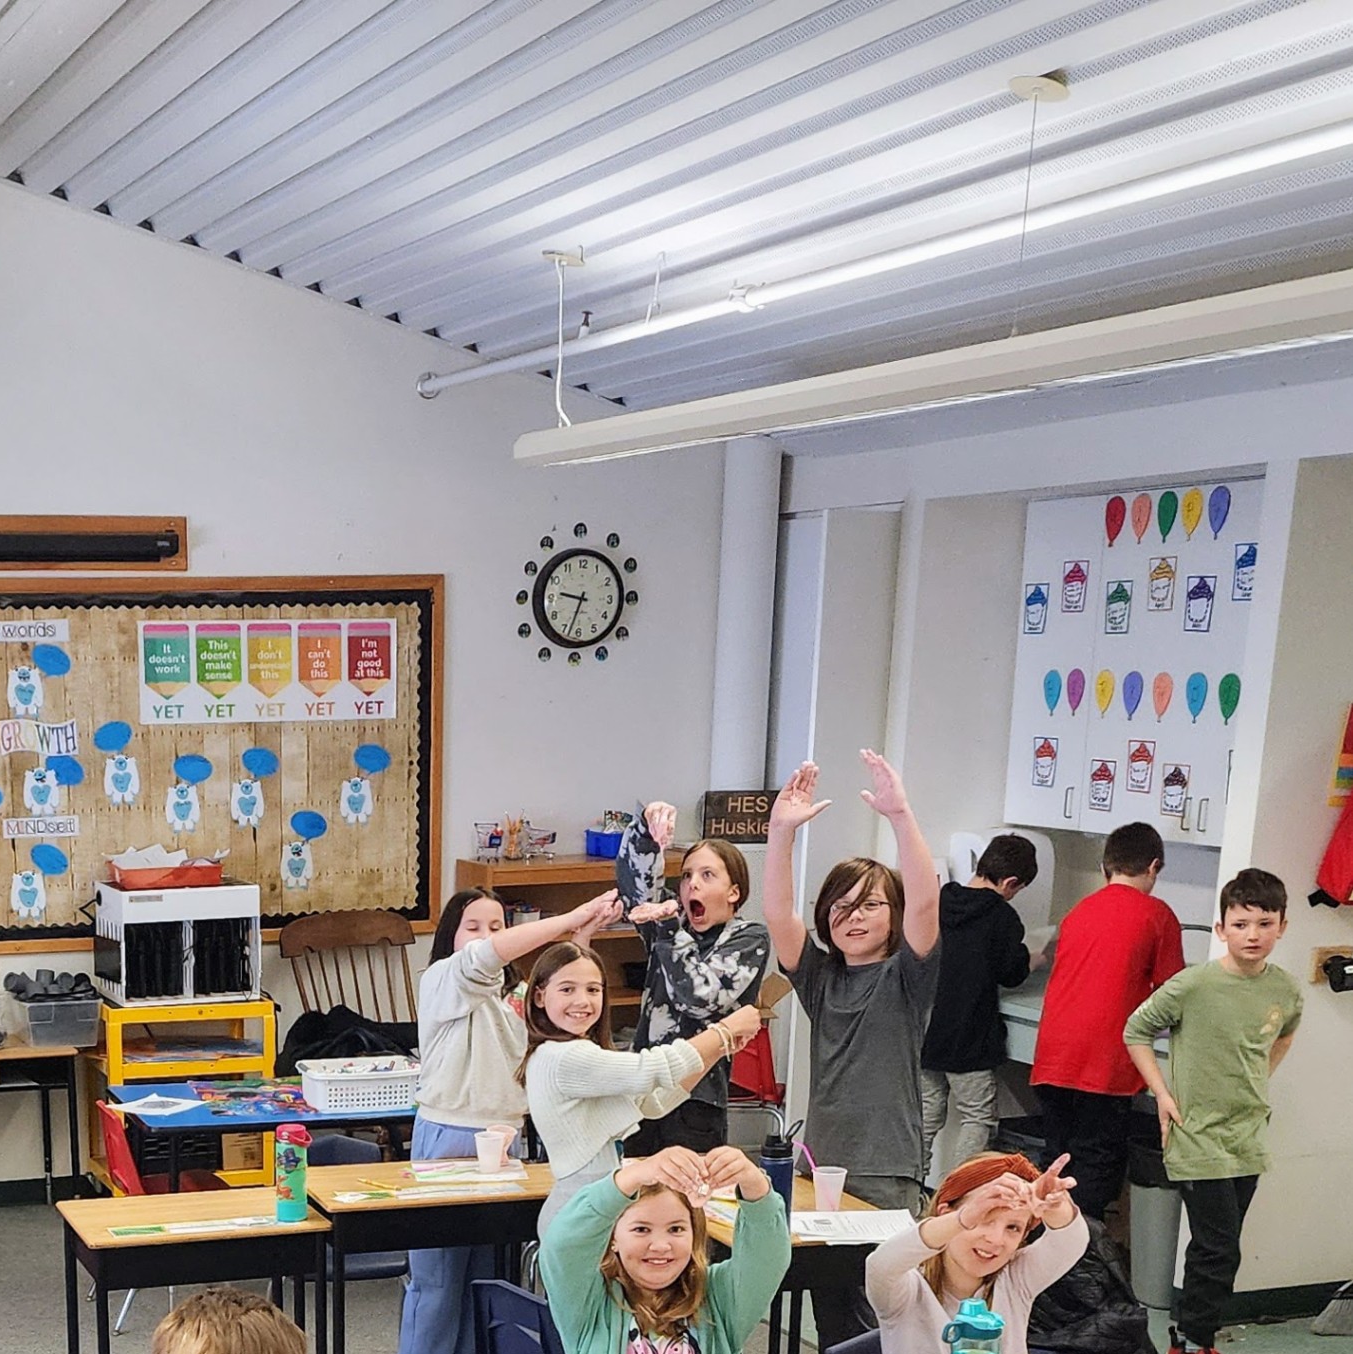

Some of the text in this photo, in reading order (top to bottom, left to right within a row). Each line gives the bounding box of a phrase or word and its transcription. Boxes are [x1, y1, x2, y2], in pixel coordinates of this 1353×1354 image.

[564, 563, 571, 573] 11
[579, 560, 588, 569] 12
[595, 565, 598, 573] 1
[551, 576, 560, 585] 10
[605, 578, 610, 586] 2
[548, 594, 554, 603] 9
[607, 595, 613, 604] 3
[551, 611, 557, 620] 8
[601, 611, 608, 620] 4
[2, 622, 56, 638] words
[561, 624, 567, 633] 7
[576, 628, 581, 637] 6
[591, 624, 597, 633] 5
[208, 640, 228, 650] This
[268, 641, 271, 649] I
[318, 640, 321, 649] I
[362, 639, 377, 648] I'm
[163, 644, 171, 653] It
[201, 651, 237, 660] doesn't
[258, 650, 282, 659] don't
[308, 650, 330, 659] can't
[361, 649, 378, 658] not
[149, 654, 186, 663] doesn't
[205, 661, 231, 670] make
[313, 660, 325, 669] do
[357, 659, 381, 669] good
[155, 664, 180, 674] work
[355, 667, 384, 678] at this
[205, 671, 232, 680] sense
[261, 670, 279, 680] this
[311, 669, 328, 679] this
[153, 705, 184, 718] YET
[204, 704, 235, 717] YET
[255, 703, 285, 717] YET
[306, 702, 335, 715] YET
[354, 700, 384, 714] YET
[1, 723, 76, 754] GROWTH
[728, 796, 768, 812] HES
